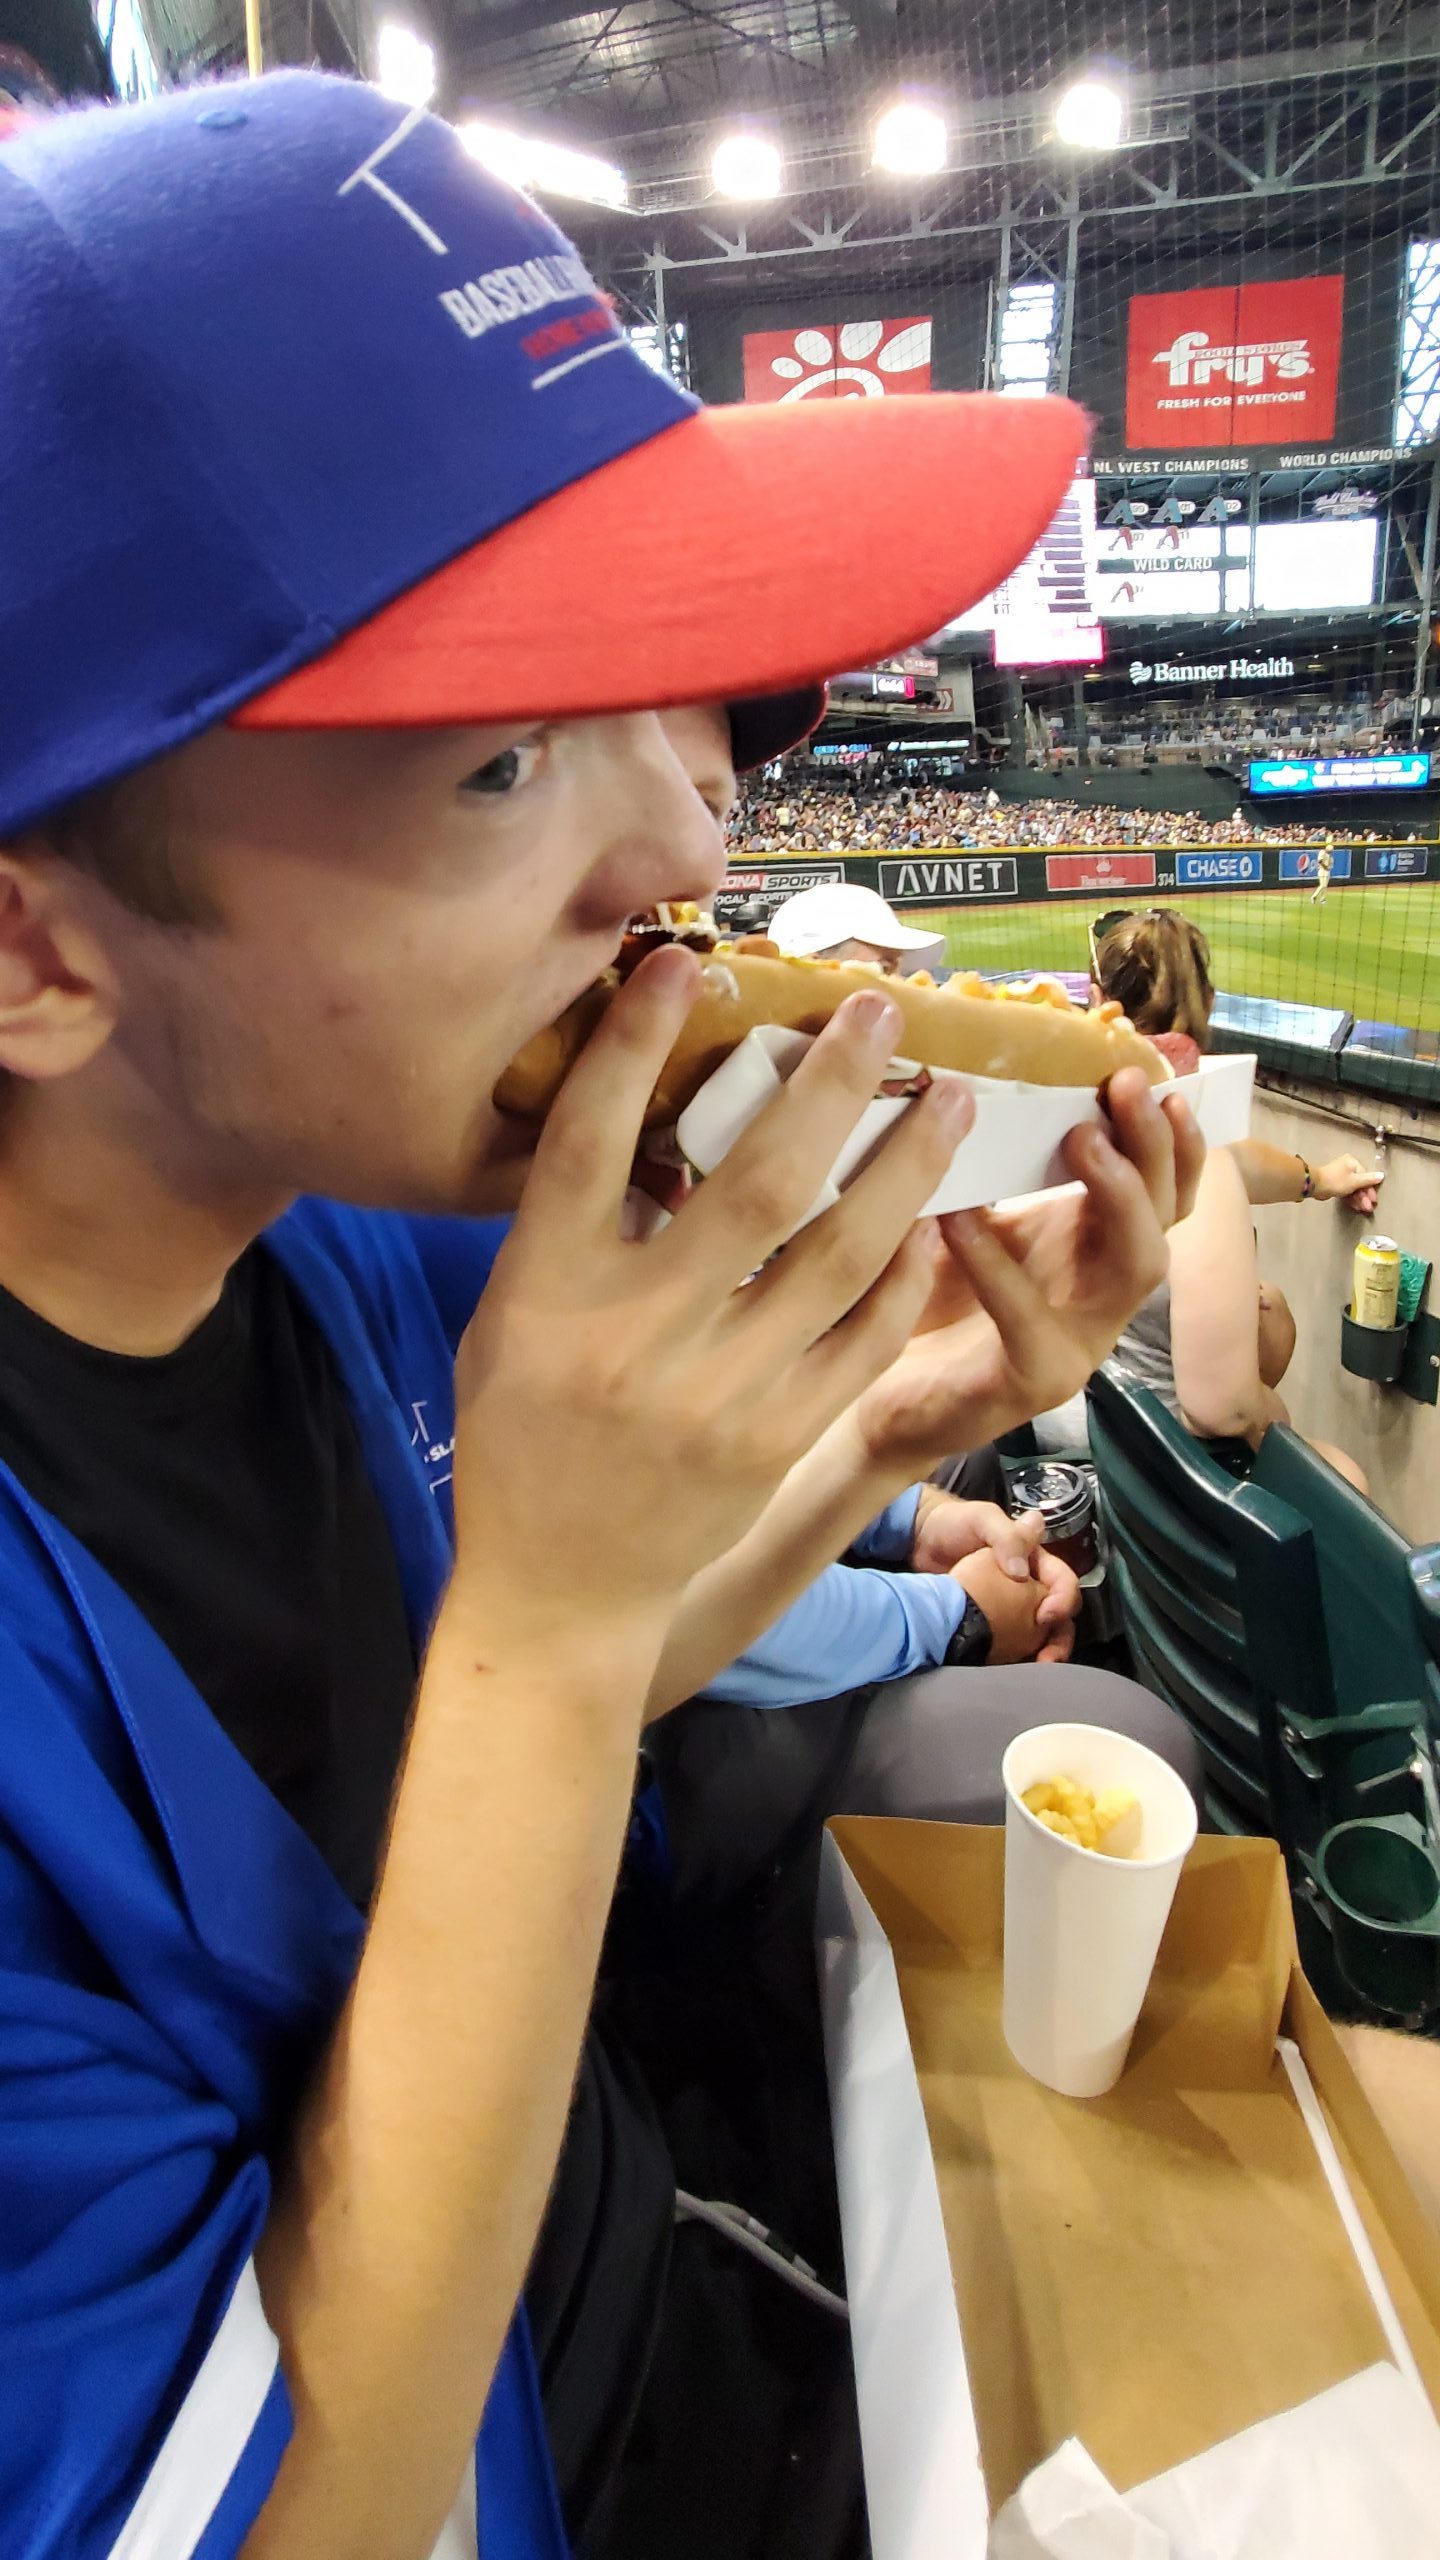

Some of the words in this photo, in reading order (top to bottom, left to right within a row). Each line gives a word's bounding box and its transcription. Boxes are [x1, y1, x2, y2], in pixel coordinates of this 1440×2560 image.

[1152, 331, 1311, 386] fry's
[1157, 397, 1200, 409] FRESH
[1203, 395, 1232, 407] FOR
[1237, 390, 1306, 405] EVERYONE
[1094, 462, 1113, 474] NL
[1118, 461, 1160, 473] WEST
[1165, 458, 1249, 472] CHAMPIONS
[1280, 453, 1326, 468] WORLD
[1329, 447, 1413, 464] CHAMPIONS
[1134, 559, 1170, 572] WILD
[1174, 557, 1212, 570] CARD
[1154, 663, 1227, 682] Banner
[1229, 656, 1294, 680] Health
[1187, 858, 1238, 878] CHASE
[767, 874, 832, 888] SPORTS
[896, 862, 1003, 896] AVNET
